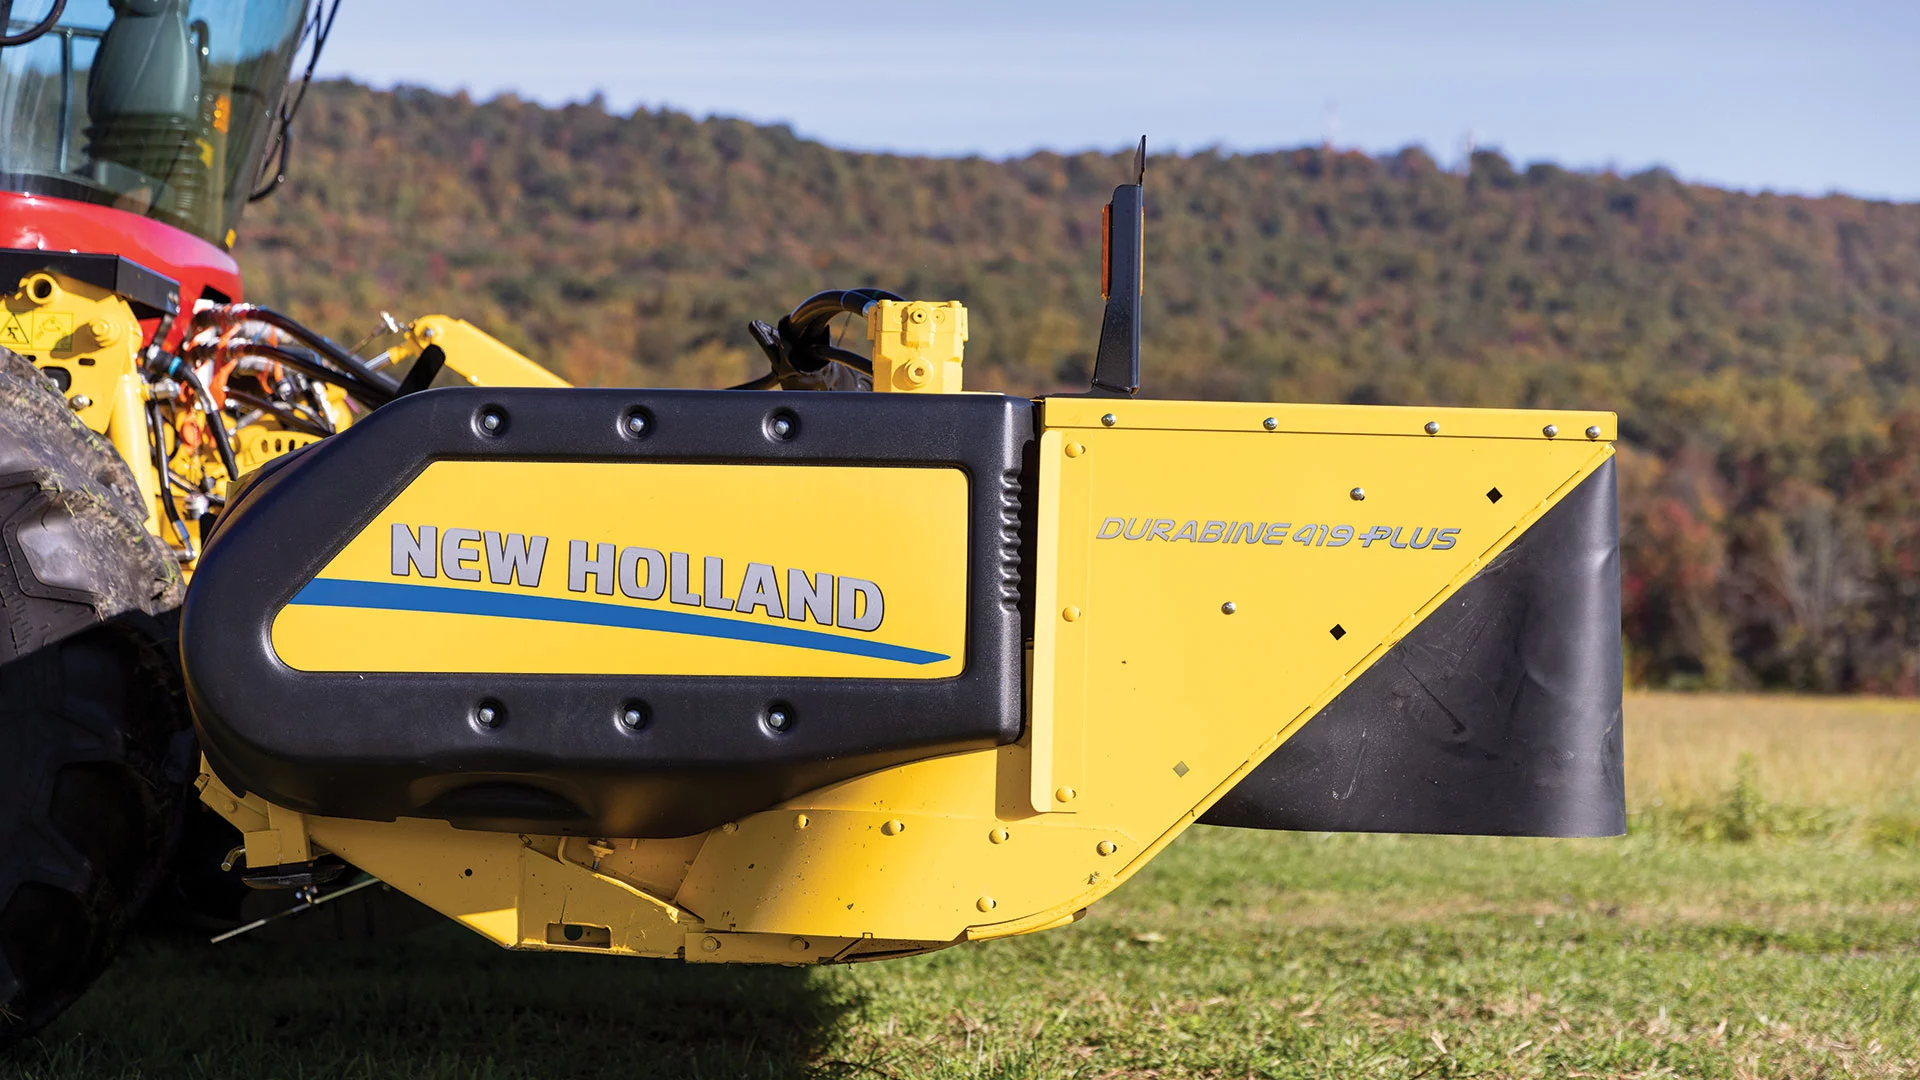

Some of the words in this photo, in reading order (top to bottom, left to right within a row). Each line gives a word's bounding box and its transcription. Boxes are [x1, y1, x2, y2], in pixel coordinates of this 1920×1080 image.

[1096, 517, 1292, 545] DURABINE
[1292, 524, 1355, 547] 419
[390, 523, 549, 588] NEW
[567, 539, 885, 632] HOLLAND
